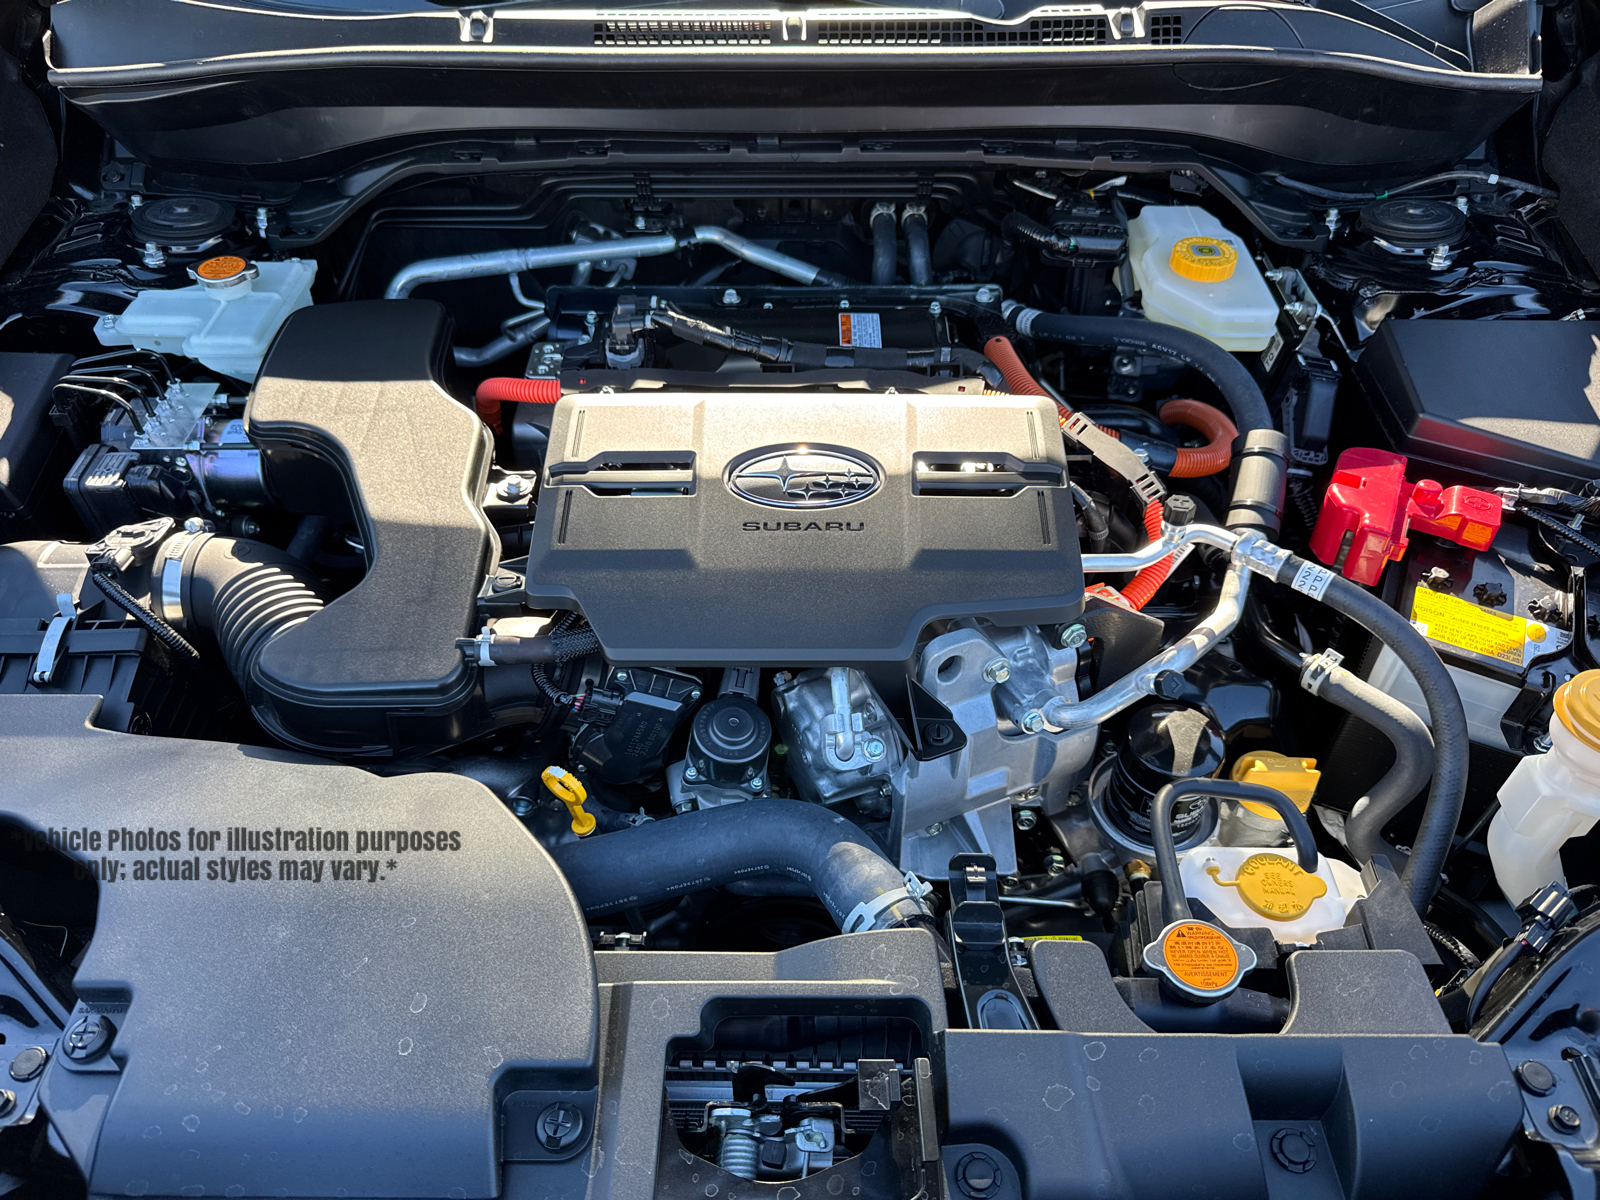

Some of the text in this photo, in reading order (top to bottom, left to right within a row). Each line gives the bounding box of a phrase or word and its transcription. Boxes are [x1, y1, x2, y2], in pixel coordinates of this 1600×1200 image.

[742, 522, 864, 531] SUBARU
[1418, 588, 1448, 601] DANGER
[1416, 604, 1509, 638] POISON CAUSES SEVERE BURNS
[1465, 642, 1478, 650] CCA
[1480, 648, 1495, 656] 470A
[1496, 646, 1522, 658] CHILDREN
[1506, 644, 1522, 654] LEVEL
[1244, 855, 1304, 876] COOLANT
[1264, 871, 1282, 880] SEE
[1262, 886, 1296, 896] MANUAL
